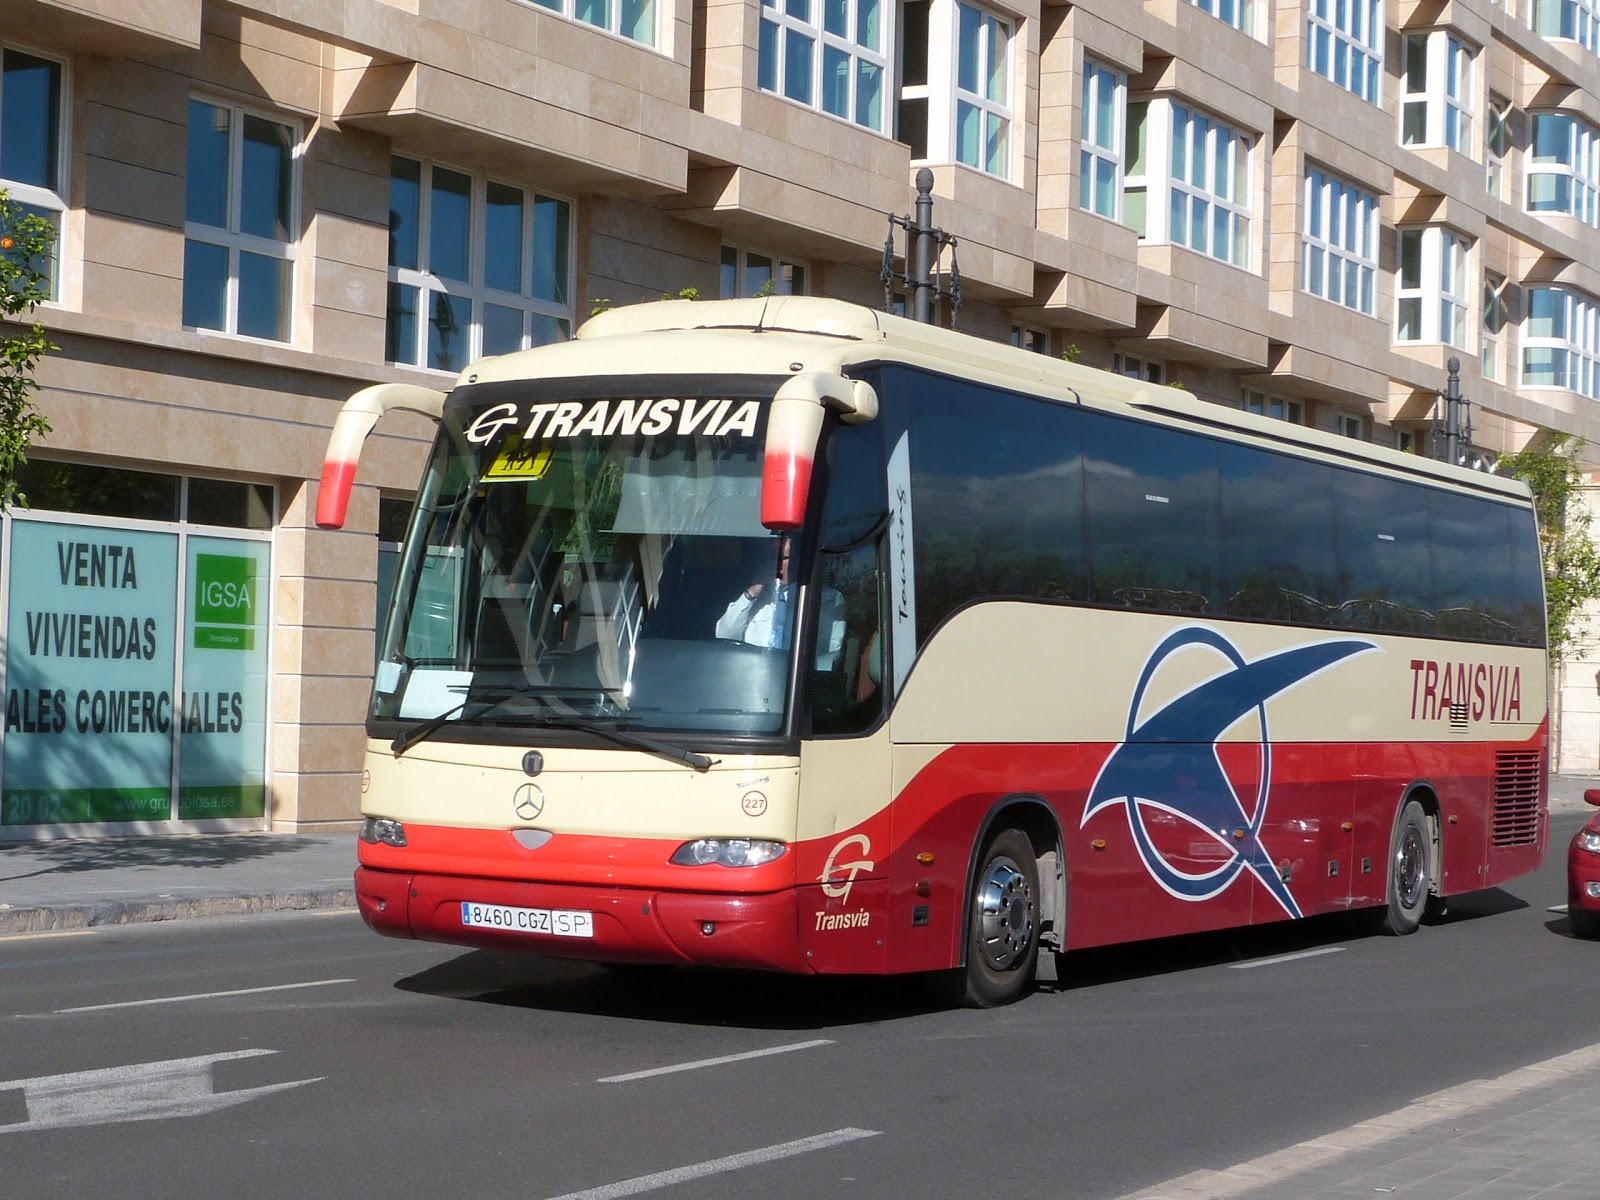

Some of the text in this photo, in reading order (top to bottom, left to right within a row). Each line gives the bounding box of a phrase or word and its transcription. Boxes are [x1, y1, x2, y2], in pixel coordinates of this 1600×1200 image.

[523, 398, 760, 439] TRANSVIA
[57, 540, 138, 590] VENTA
[201, 581, 252, 609] IGSA
[26, 611, 156, 661] VIVIENDAS
[1410, 659, 1521, 722] TRANSVIA
[75, 690, 243, 735] COMERCIALES
[744, 799, 764, 809] 227
[473, 906, 586, 933] 8460 CGZ SP
[815, 907, 870, 931] Transvia
